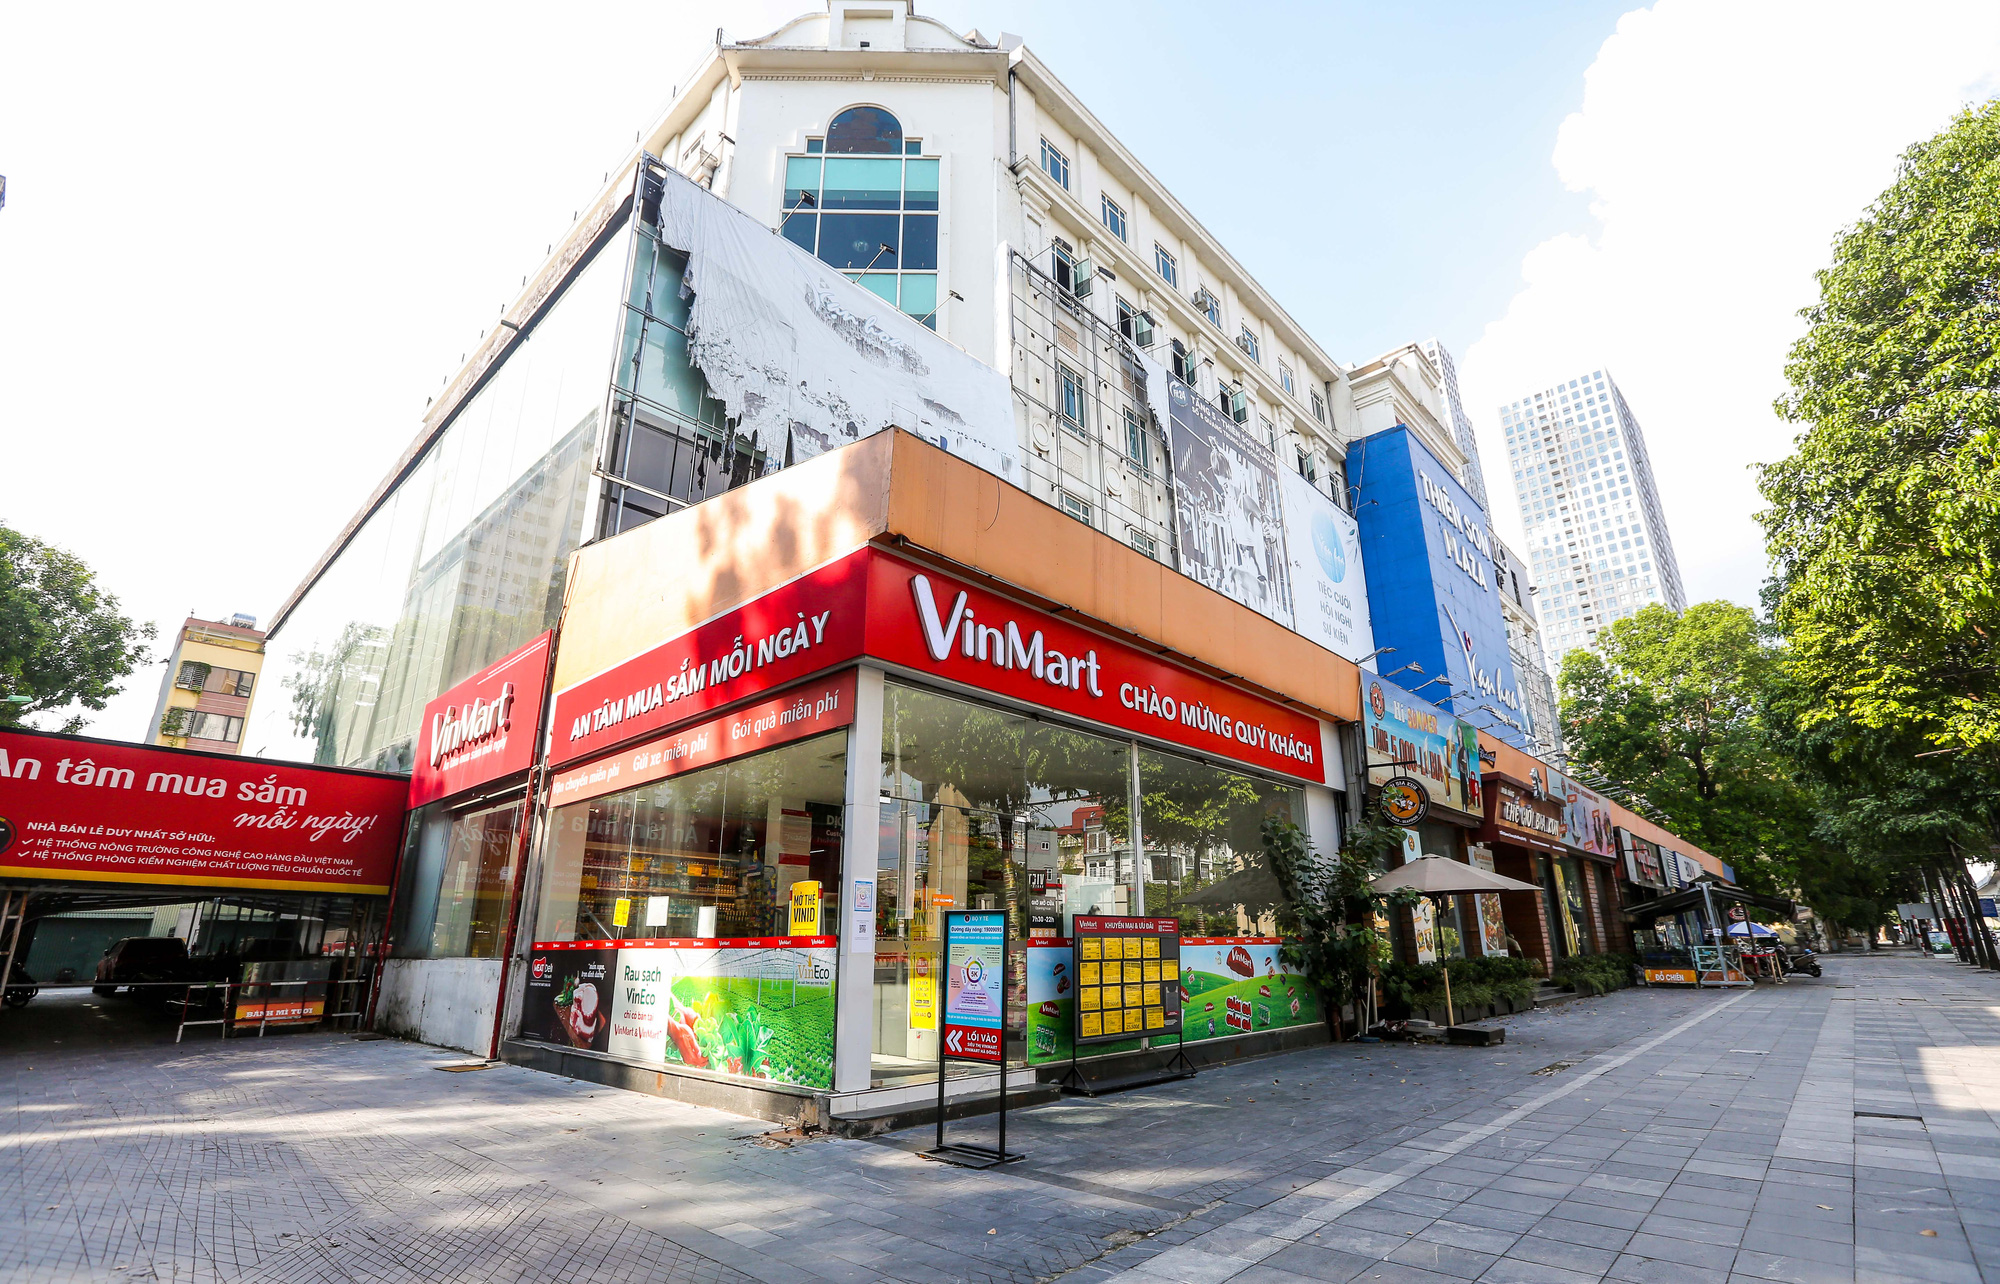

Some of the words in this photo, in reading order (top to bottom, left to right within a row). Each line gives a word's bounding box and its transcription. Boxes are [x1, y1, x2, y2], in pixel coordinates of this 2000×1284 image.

[1418, 468, 1463, 534] THIÊN
[1463, 514, 1491, 562] SƠN
[1317, 580, 1333, 599] TIỆC
[1320, 601, 1334, 619] HỘI
[1335, 608, 1353, 633] NGHỊ
[910, 573, 1104, 698] VinMart
[1333, 627, 1349, 646] KIỆN
[570, 711, 593, 742] AN
[593, 698, 624, 731] TÂM
[626, 683, 664, 719] MUA
[665, 657, 707, 703] SẮM
[709, 635, 754, 688] MỖI
[757, 610, 831, 668] NGÀY
[430, 682, 513, 769] VinMart
[732, 719, 752, 740] Gói
[754, 711, 777, 738] quà
[780, 698, 812, 726] miễn
[815, 689, 840, 720] phí
[1119, 680, 1178, 723] CHÀO
[1180, 701, 1233, 741] MỪNG
[1234, 719, 1268, 752] QUÝ
[1269, 731, 1314, 766] KHÁCH
[649, 752, 661, 767] xe
[663, 738, 688, 763] miễn
[689, 732, 708, 760] phí
[56, 758, 135, 790] tâm
[146, 772, 228, 799] mua
[236, 774, 308, 807] sắm
[27, 822, 56, 832] NHÀ
[59, 823, 87, 834] BÁN
[89, 824, 104, 836] LẺ
[106, 829, 133, 838] DUY
[134, 828, 169, 840] NHẤT
[169, 831, 187, 841] SỞ
[233, 806, 298, 829] mỗi
[300, 811, 378, 843] ngày!
[32, 849, 50, 860] HỆ
[52, 851, 93, 862] THỐNG
[95, 854, 136, 864] PHÒNG
[166, 858, 207, 869] NGHIỆM
[208, 859, 236, 869] CHẤT
[236, 862, 270, 872] LƯỢNG
[271, 863, 291, 873] TIÊU
[325, 868, 351, 877] QUỐC
[352, 868, 363, 877] TẾ
[36, 838, 54, 848] HỆ
[55, 839, 97, 850] THỐNG
[99, 842, 134, 853] NÔNG
[135, 845, 180, 855] TRƯỜNG
[181, 847, 212, 857] CÔNG
[213, 849, 242, 859] NGHỆ
[243, 852, 264, 860] CAO
[265, 852, 292, 862] HÀNG
[293, 853, 313, 864] ĐẦU
[314, 855, 333, 866] VIỆT
[333, 858, 354, 866] NAM
[793, 907, 815, 923] VINID
[797, 964, 830, 980] VinEco
[1231, 949, 1252, 969] VinMart
[624, 965, 640, 982] Rau
[641, 966, 662, 987] sạch
[626, 987, 656, 1006] VinEco
[614, 1023, 634, 1036] VinMart
[634, 1029, 638, 1038] &
[967, 1030, 980, 1042] LỐI
[980, 1032, 998, 1044] VÀO
